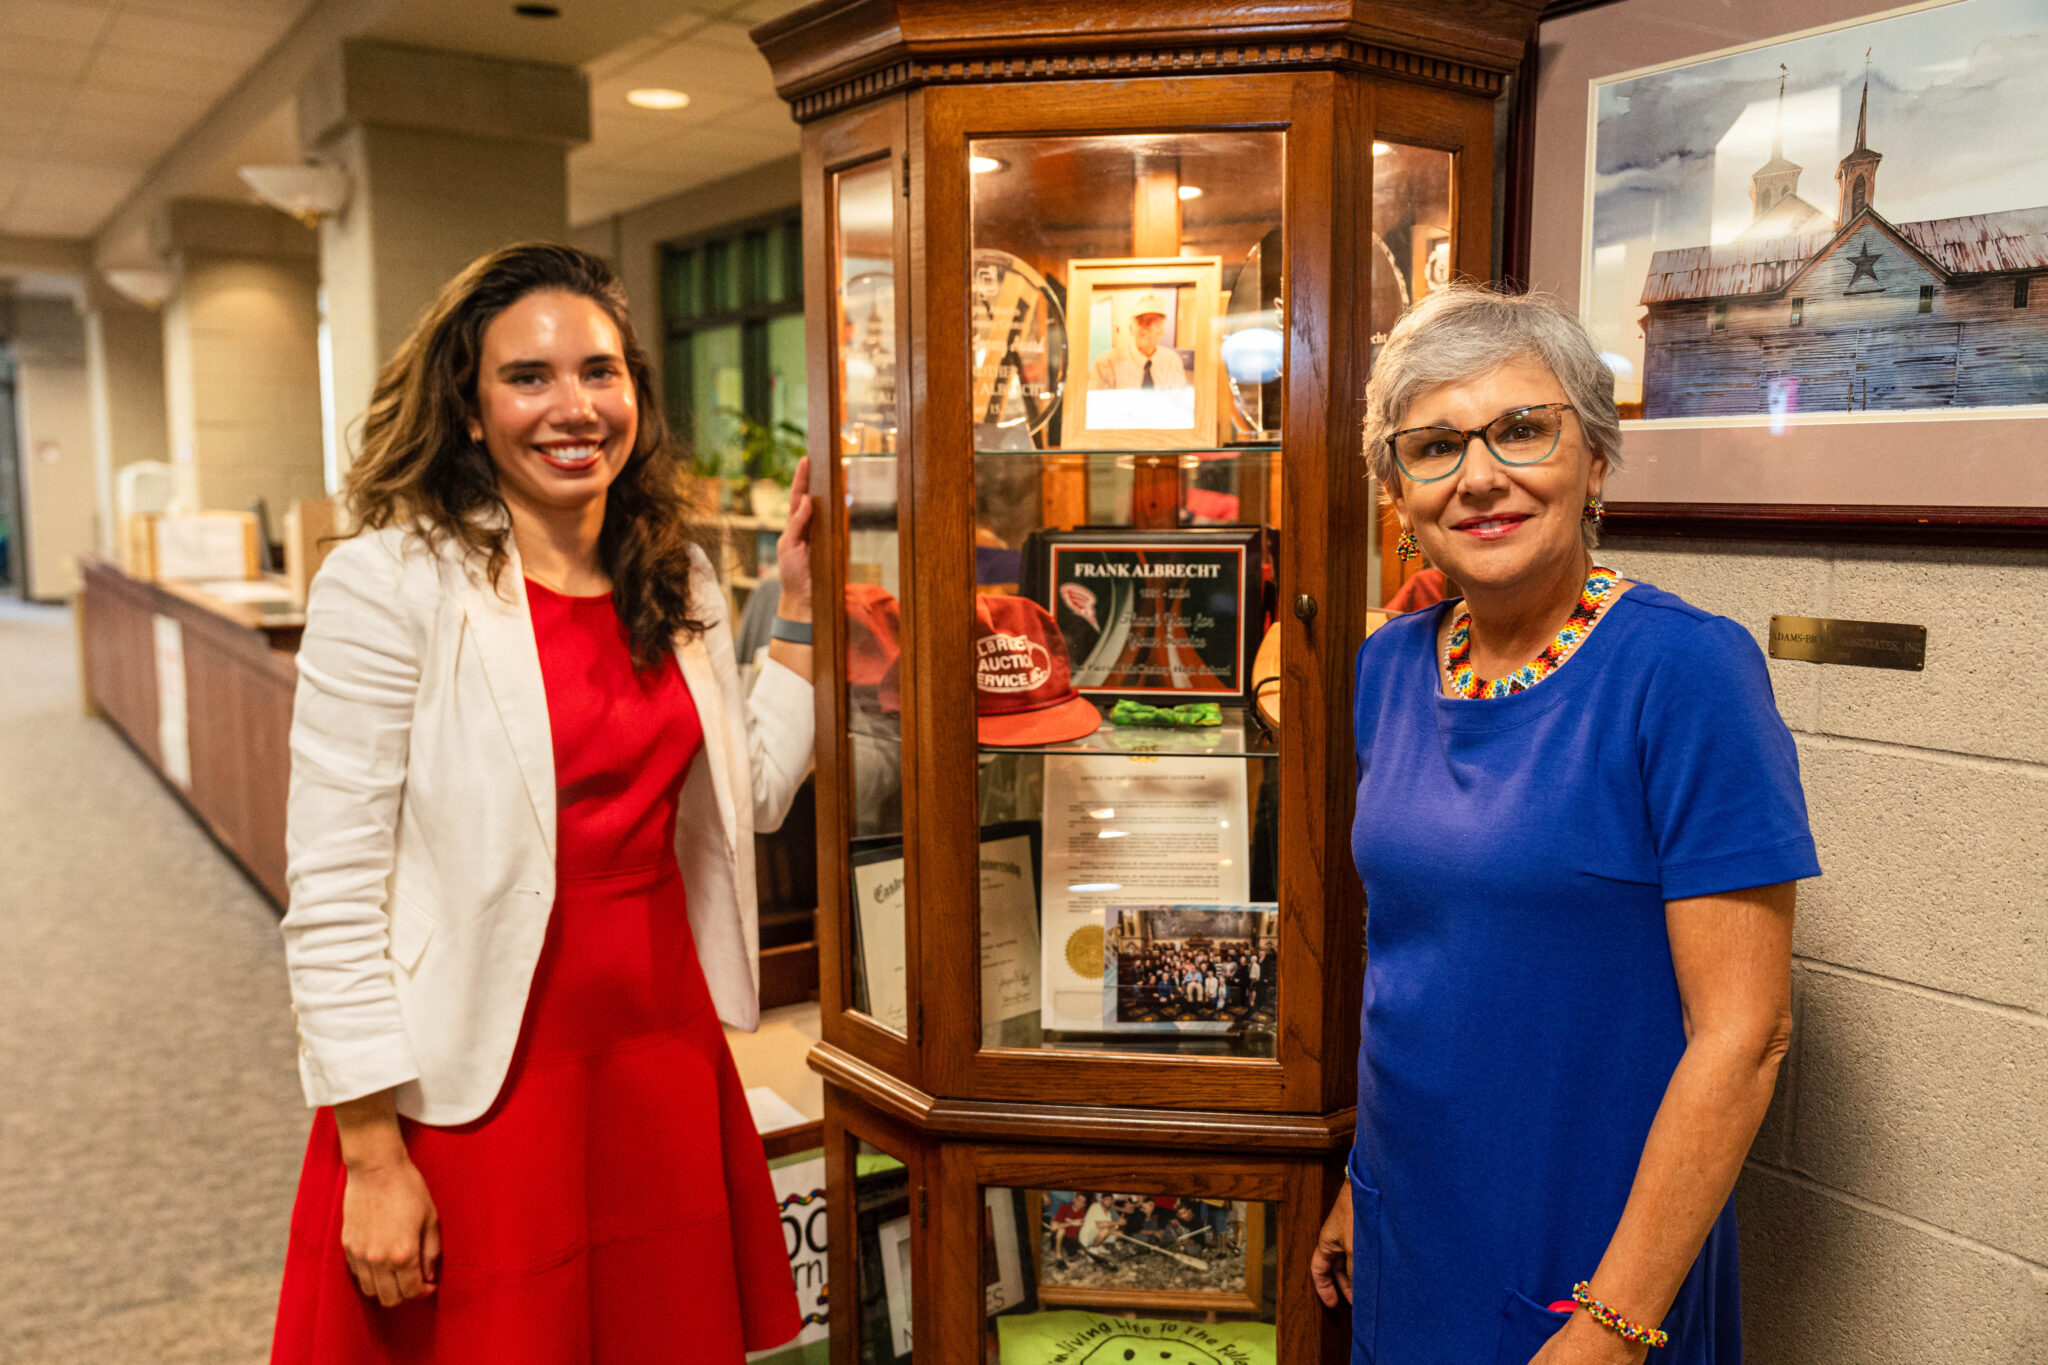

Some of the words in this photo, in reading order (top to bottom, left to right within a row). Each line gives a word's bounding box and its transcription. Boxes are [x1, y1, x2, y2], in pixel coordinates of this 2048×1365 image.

[1370, 331, 1387, 344] cht
[1074, 563, 1131, 578] FRANK
[1132, 563, 1221, 578] ALBRECHT
[976, 637, 1027, 657] LBREC
[977, 654, 1035, 672] AUCTIO
[976, 673, 1029, 687] ERVICE
[1184, 1325, 1219, 1346] The
